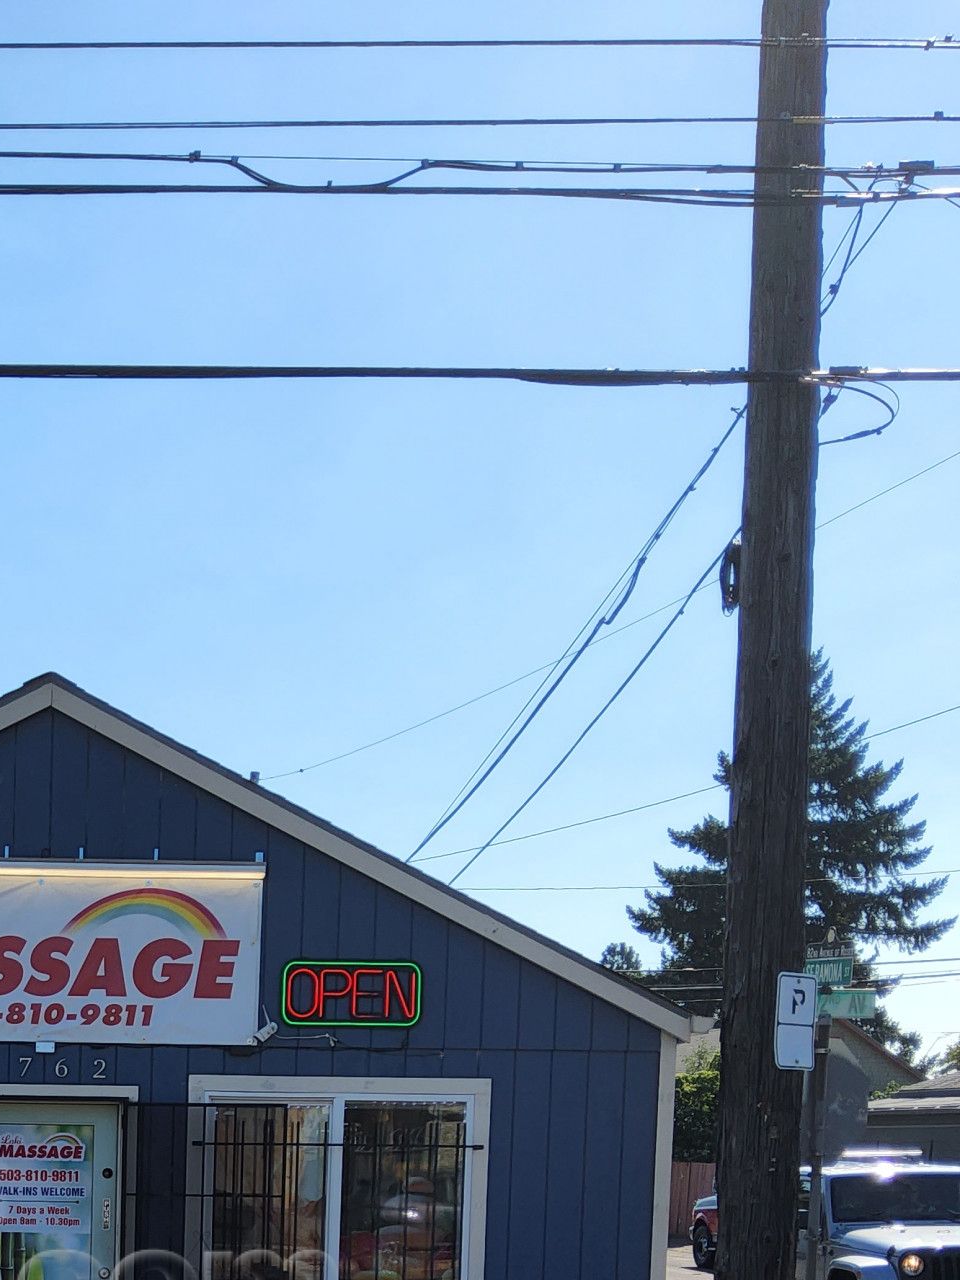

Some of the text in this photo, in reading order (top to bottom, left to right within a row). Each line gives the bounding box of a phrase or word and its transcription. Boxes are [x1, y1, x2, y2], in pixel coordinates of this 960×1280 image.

[815, 962, 842, 983] RAMONA
[287, 967, 417, 1018] OPEN
[0, 1169, 79, 1182] 503-810-9811
[41, 1187, 85, 1197] WELCOME
[8, 1205, 13, 1214] 7
[16, 1205, 36, 1215] Days
[47, 1206, 70, 1215] Week
